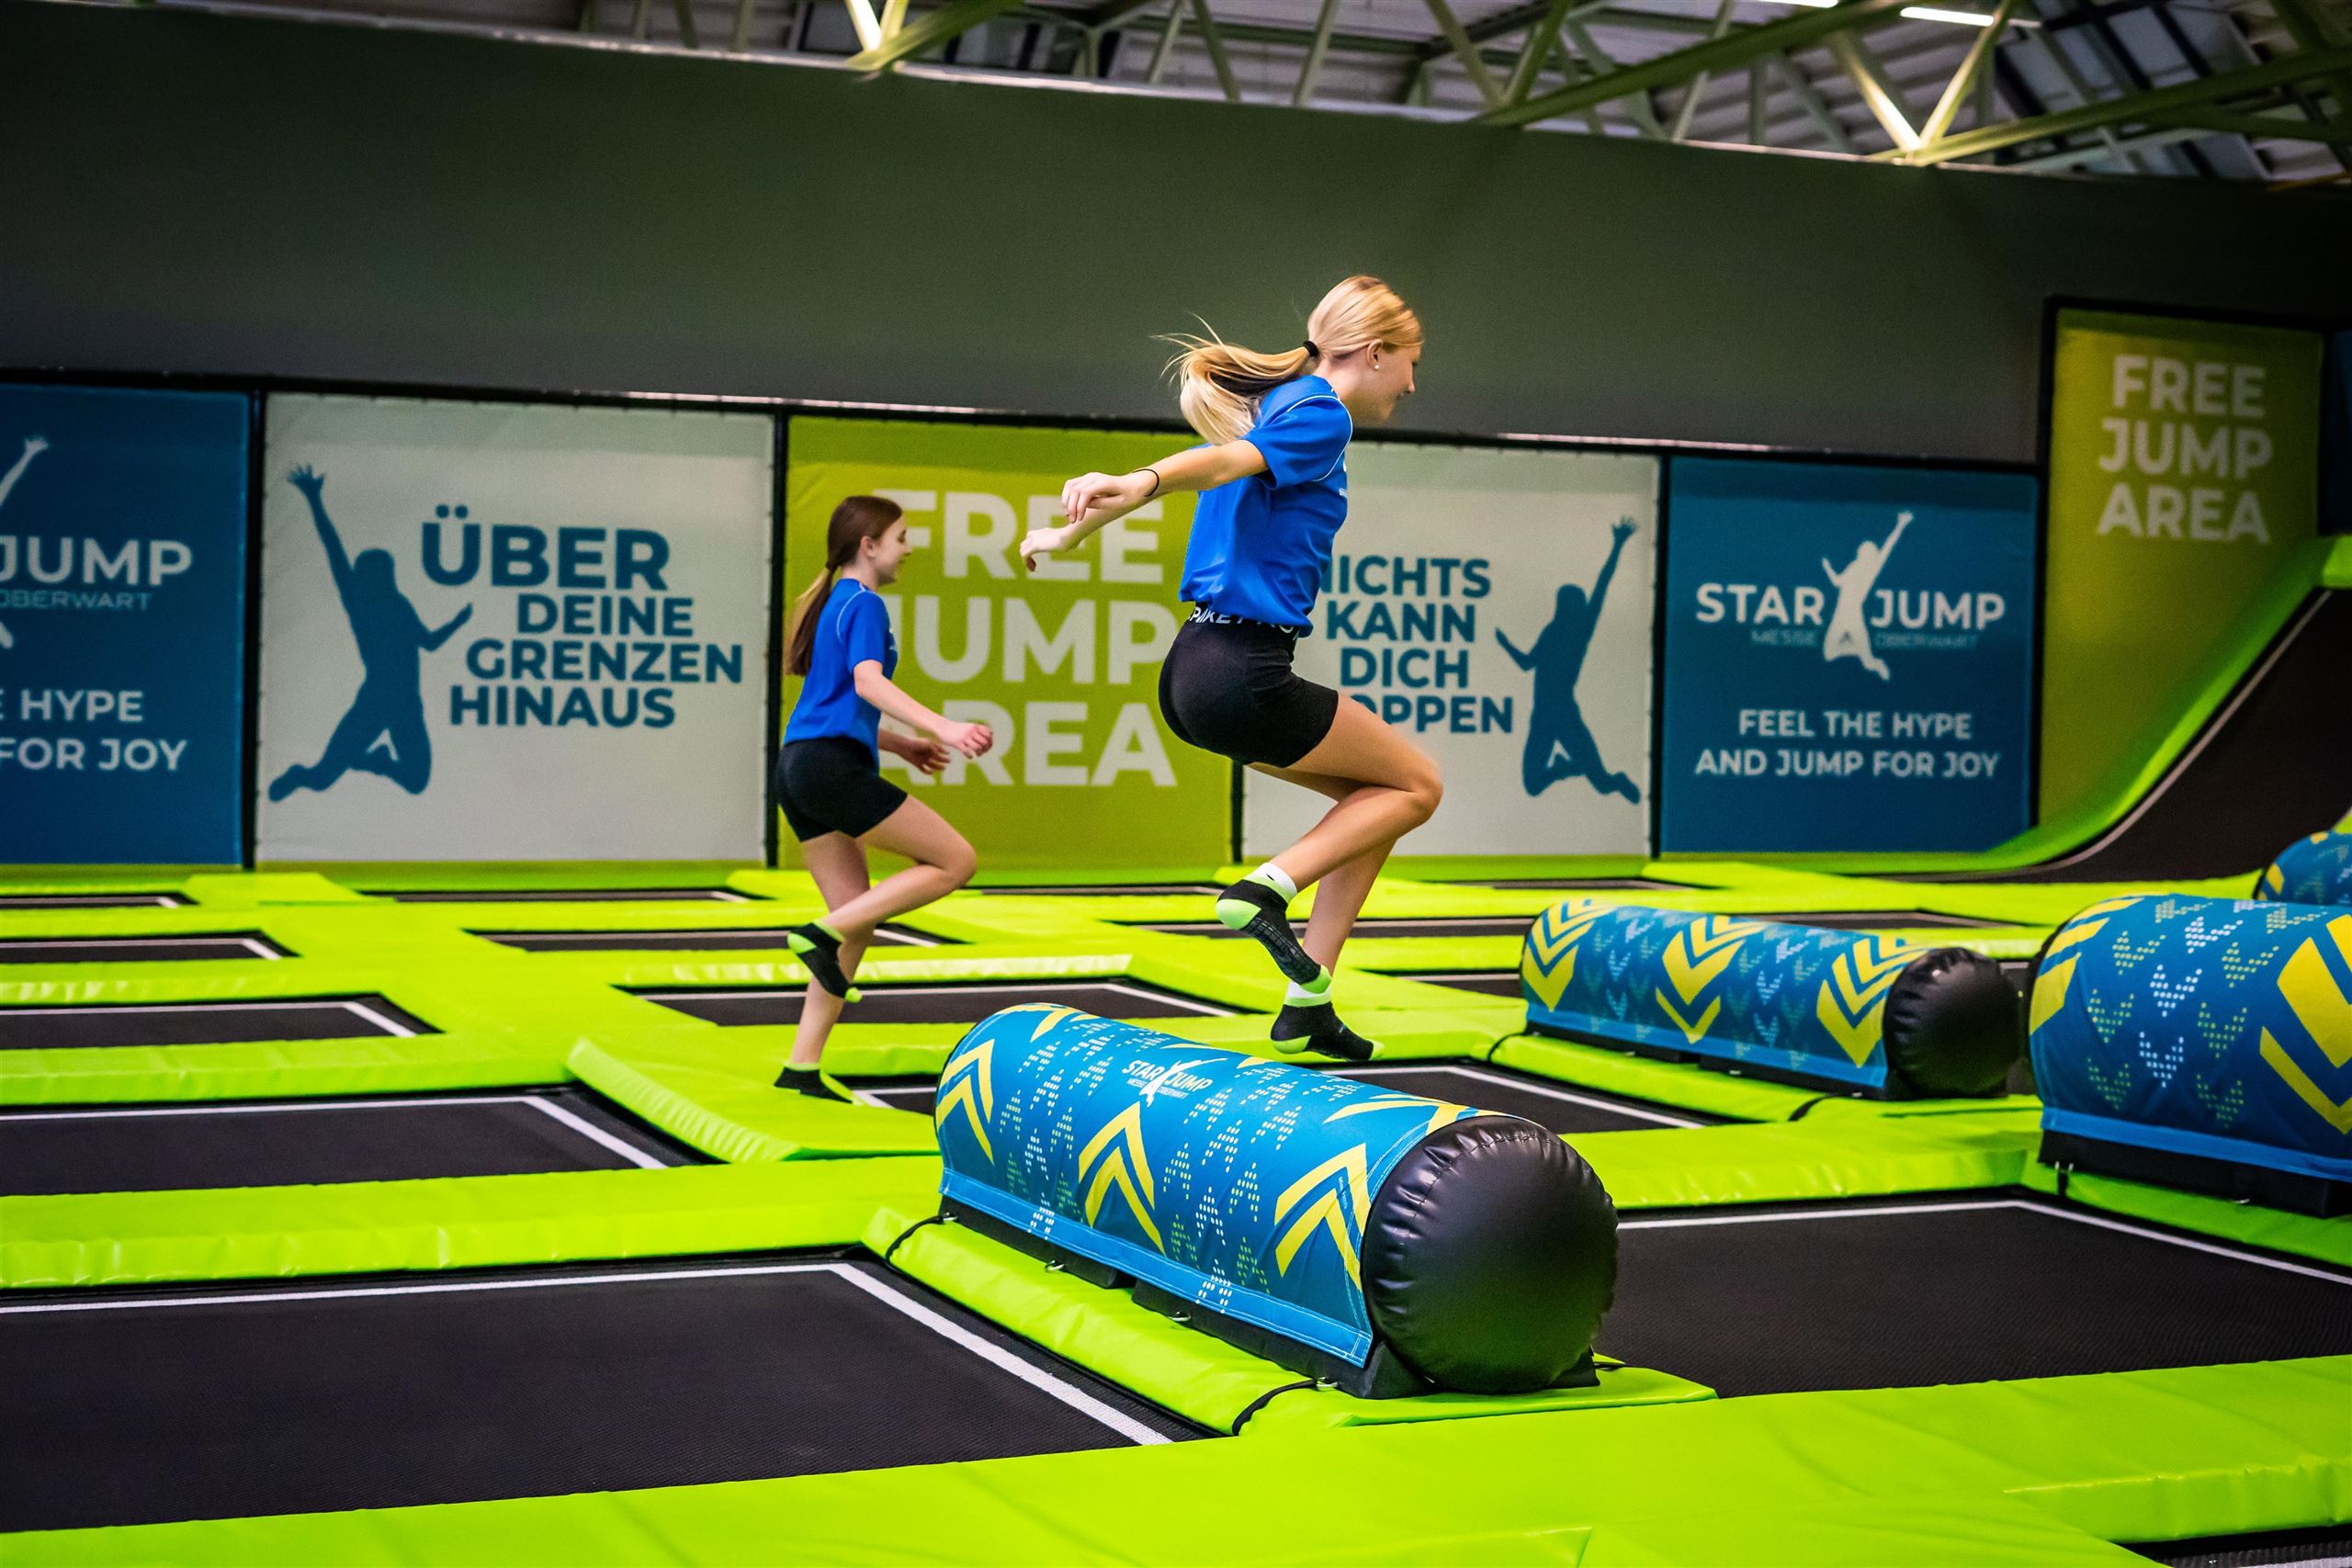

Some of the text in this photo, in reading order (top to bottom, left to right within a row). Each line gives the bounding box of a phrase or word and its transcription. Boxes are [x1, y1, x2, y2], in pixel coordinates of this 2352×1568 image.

[2114, 355, 2266, 418] FREE
[2098, 417, 2273, 479] JUMP
[2098, 481, 2269, 544] AREA
[422, 503, 670, 591] ÜBER
[517, 593, 694, 637] DEINE
[1326, 600, 1476, 643] KANN
[1696, 582, 2005, 630] STAR JUMP
[466, 637, 742, 684] GRENZEN
[1340, 647, 1469, 688] DICH
[21, 689, 143, 722] HYPE
[450, 684, 675, 728] HINAUS
[1739, 709, 1972, 739] FEEL THE HYPE
[98, 738, 187, 771] JOY
[1695, 750, 2000, 778] AND JUMP FOR JOY
[1122, 1060, 1214, 1092] STAR JUMP
